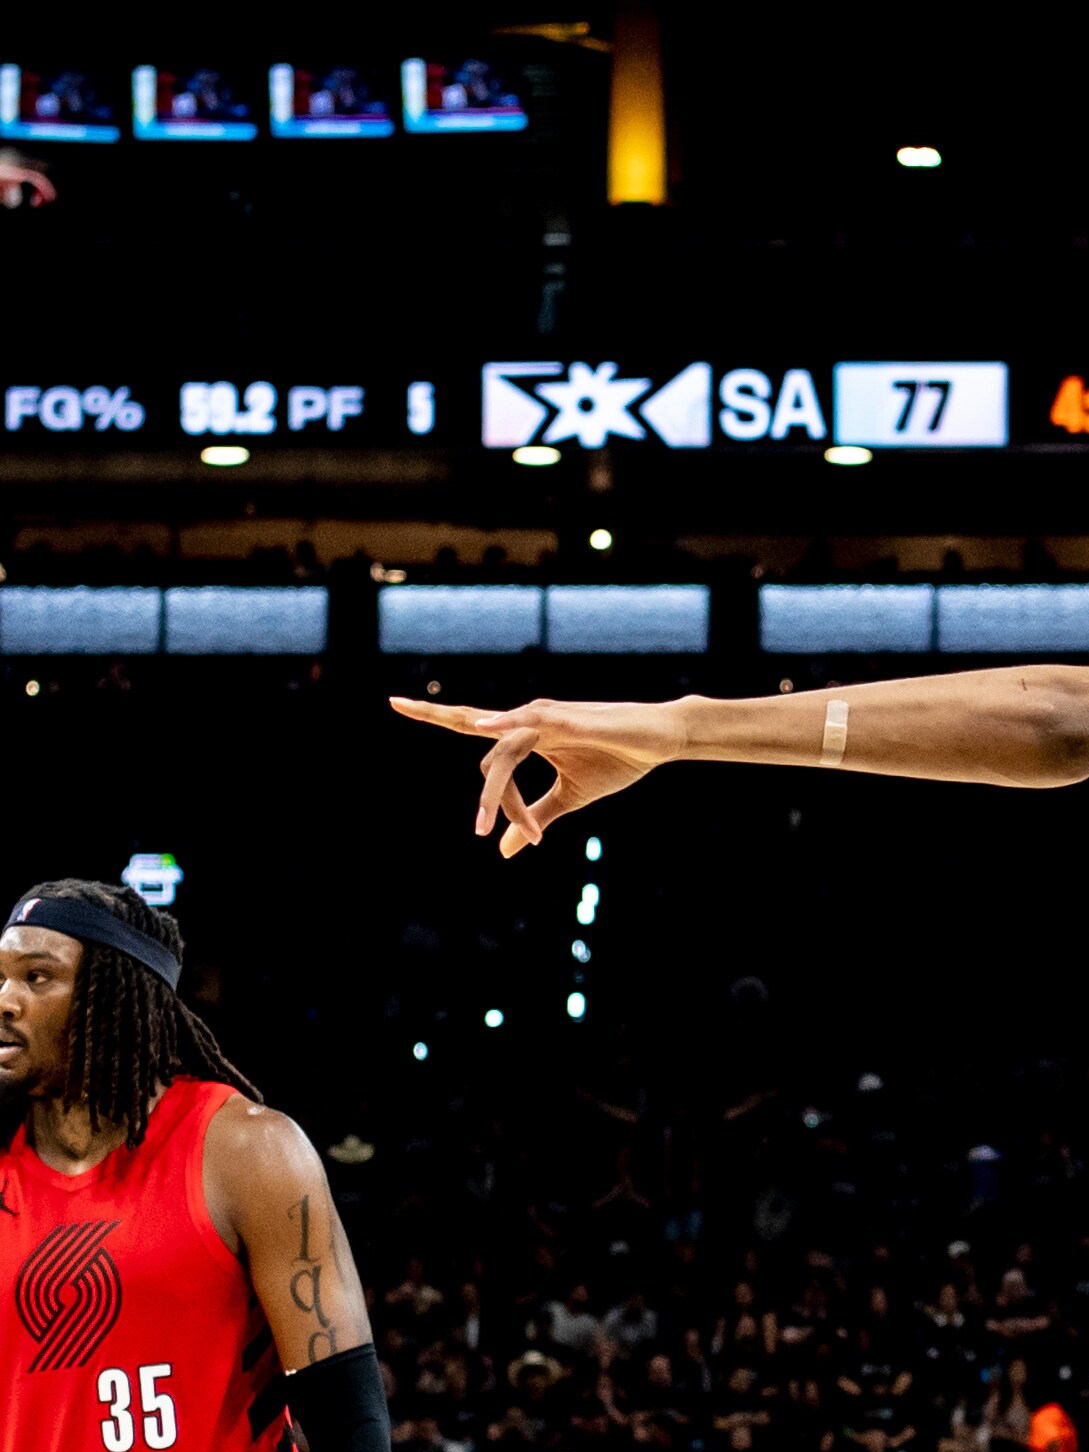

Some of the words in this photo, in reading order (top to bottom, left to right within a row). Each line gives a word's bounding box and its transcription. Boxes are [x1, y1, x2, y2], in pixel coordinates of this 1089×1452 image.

[5, 386, 145, 431] FG%
[288, 386, 364, 431] PF
[719, 368, 827, 440] SA
[894, 381, 952, 433] 77
